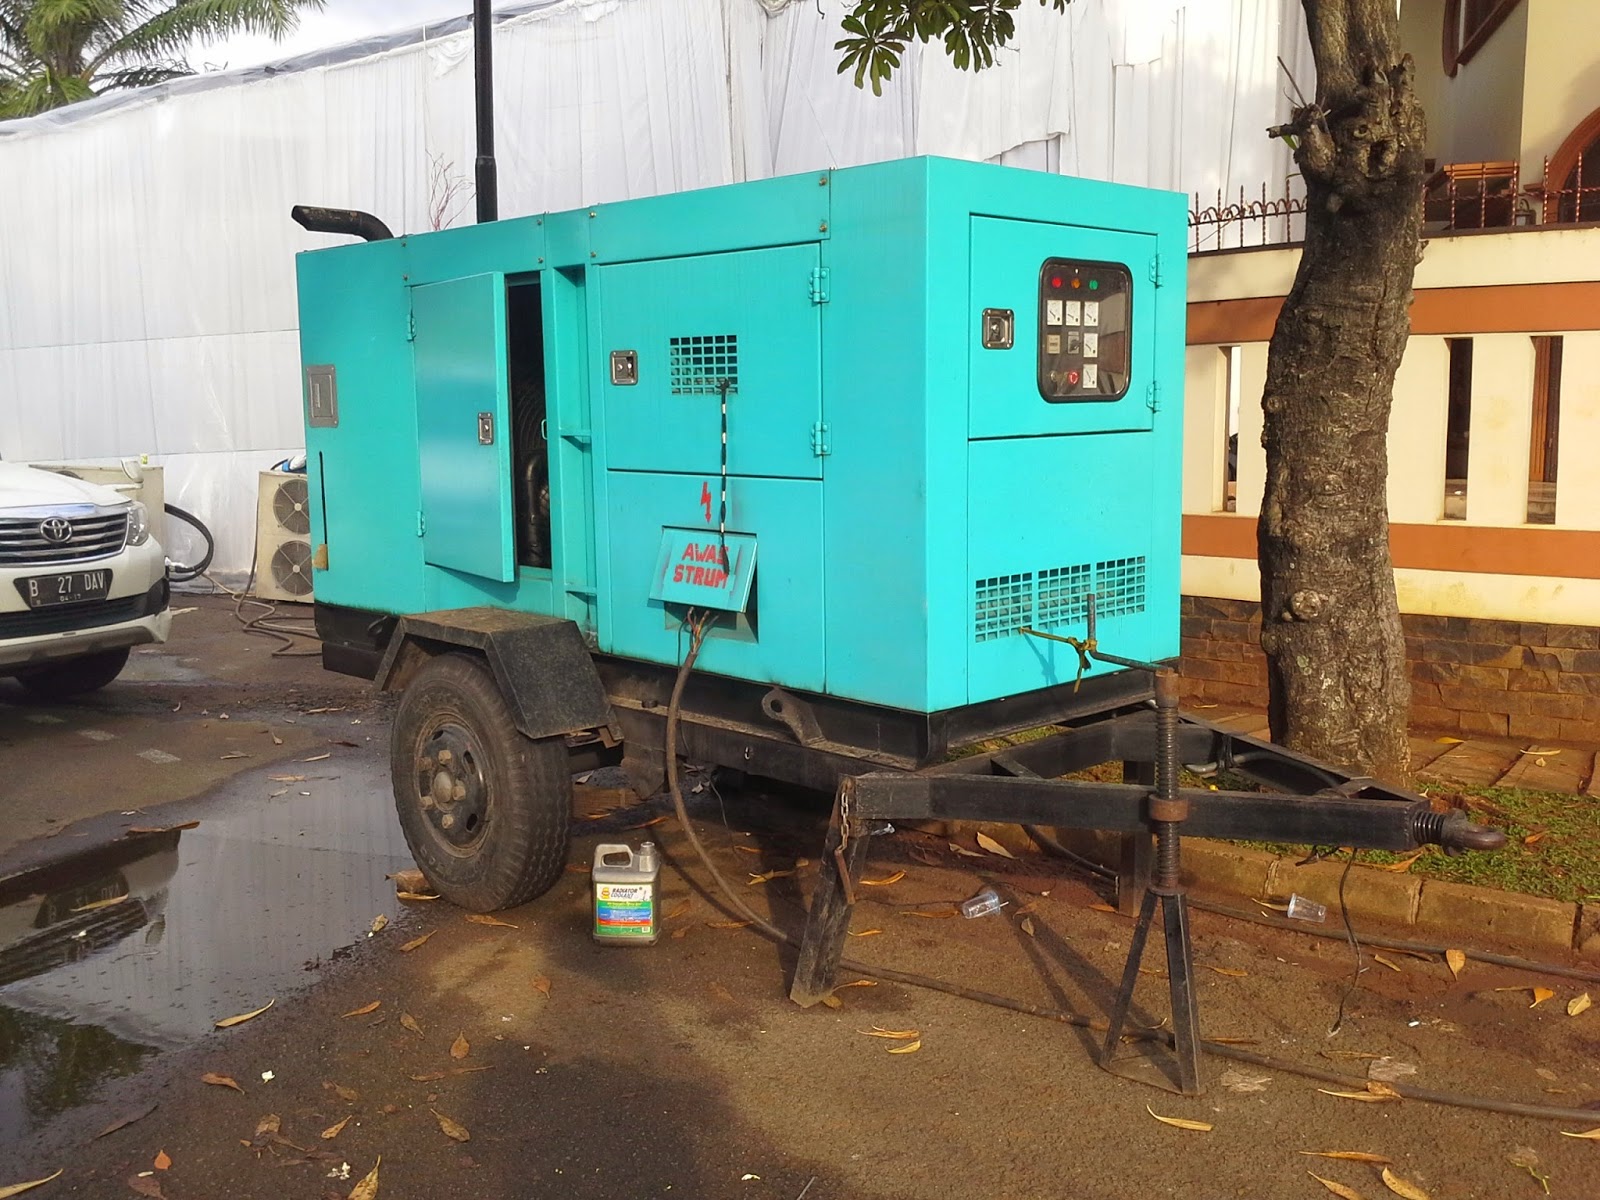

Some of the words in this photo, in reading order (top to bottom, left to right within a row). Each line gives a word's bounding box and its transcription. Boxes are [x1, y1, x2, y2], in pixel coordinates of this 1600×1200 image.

[29, 579, 39, 597] B
[57, 575, 73, 594] 27
[84, 572, 104, 591] DAV
[673, 564, 728, 589] STRUM
